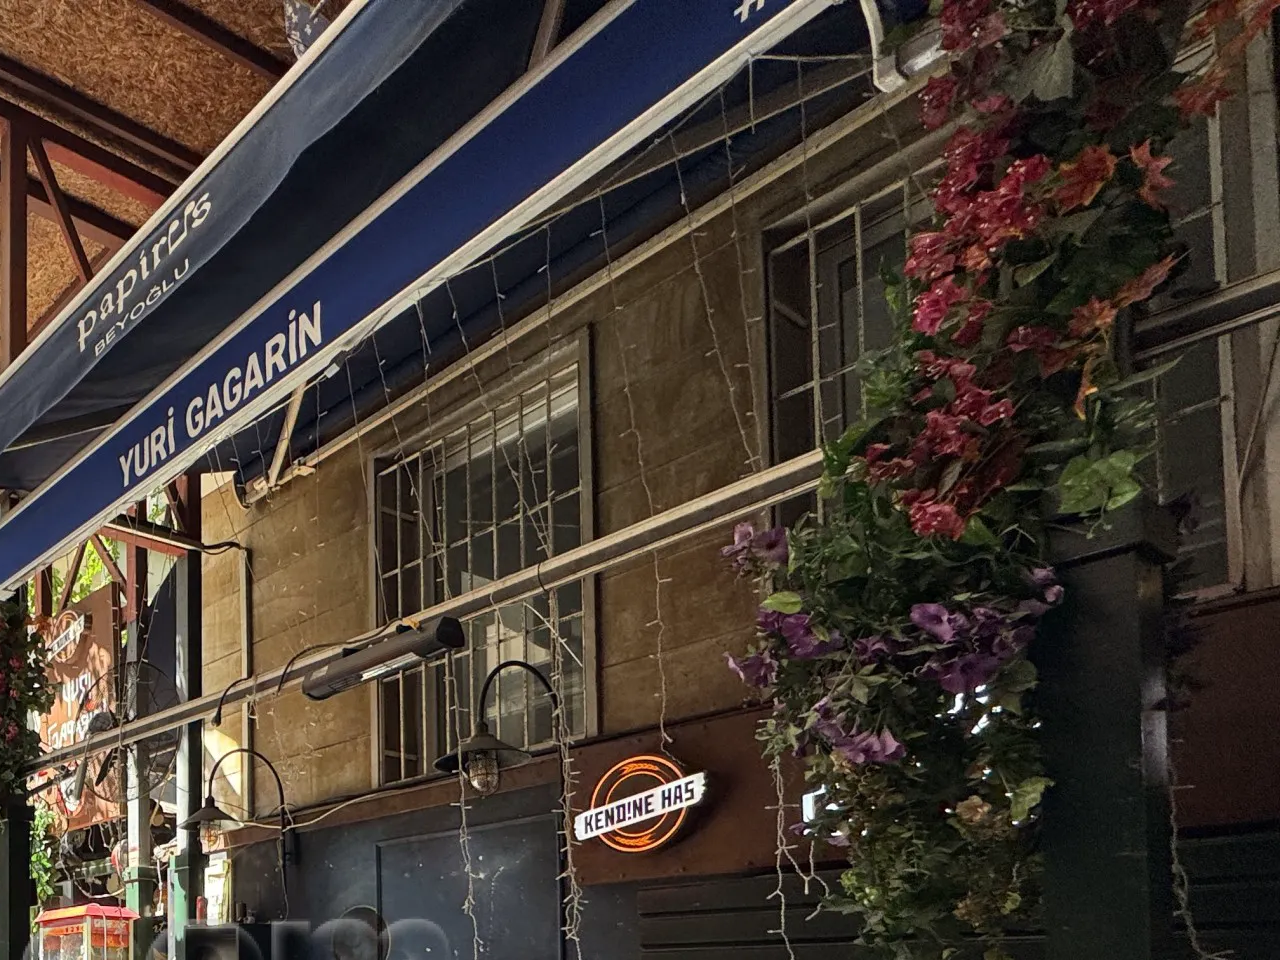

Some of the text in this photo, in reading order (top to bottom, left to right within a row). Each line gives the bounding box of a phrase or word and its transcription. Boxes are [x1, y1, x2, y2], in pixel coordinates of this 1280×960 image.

[94, 258, 190, 358] BEYOĞLU
[119, 300, 322, 489] YURİ GAGARİN
[661, 780, 695, 809] HAS
